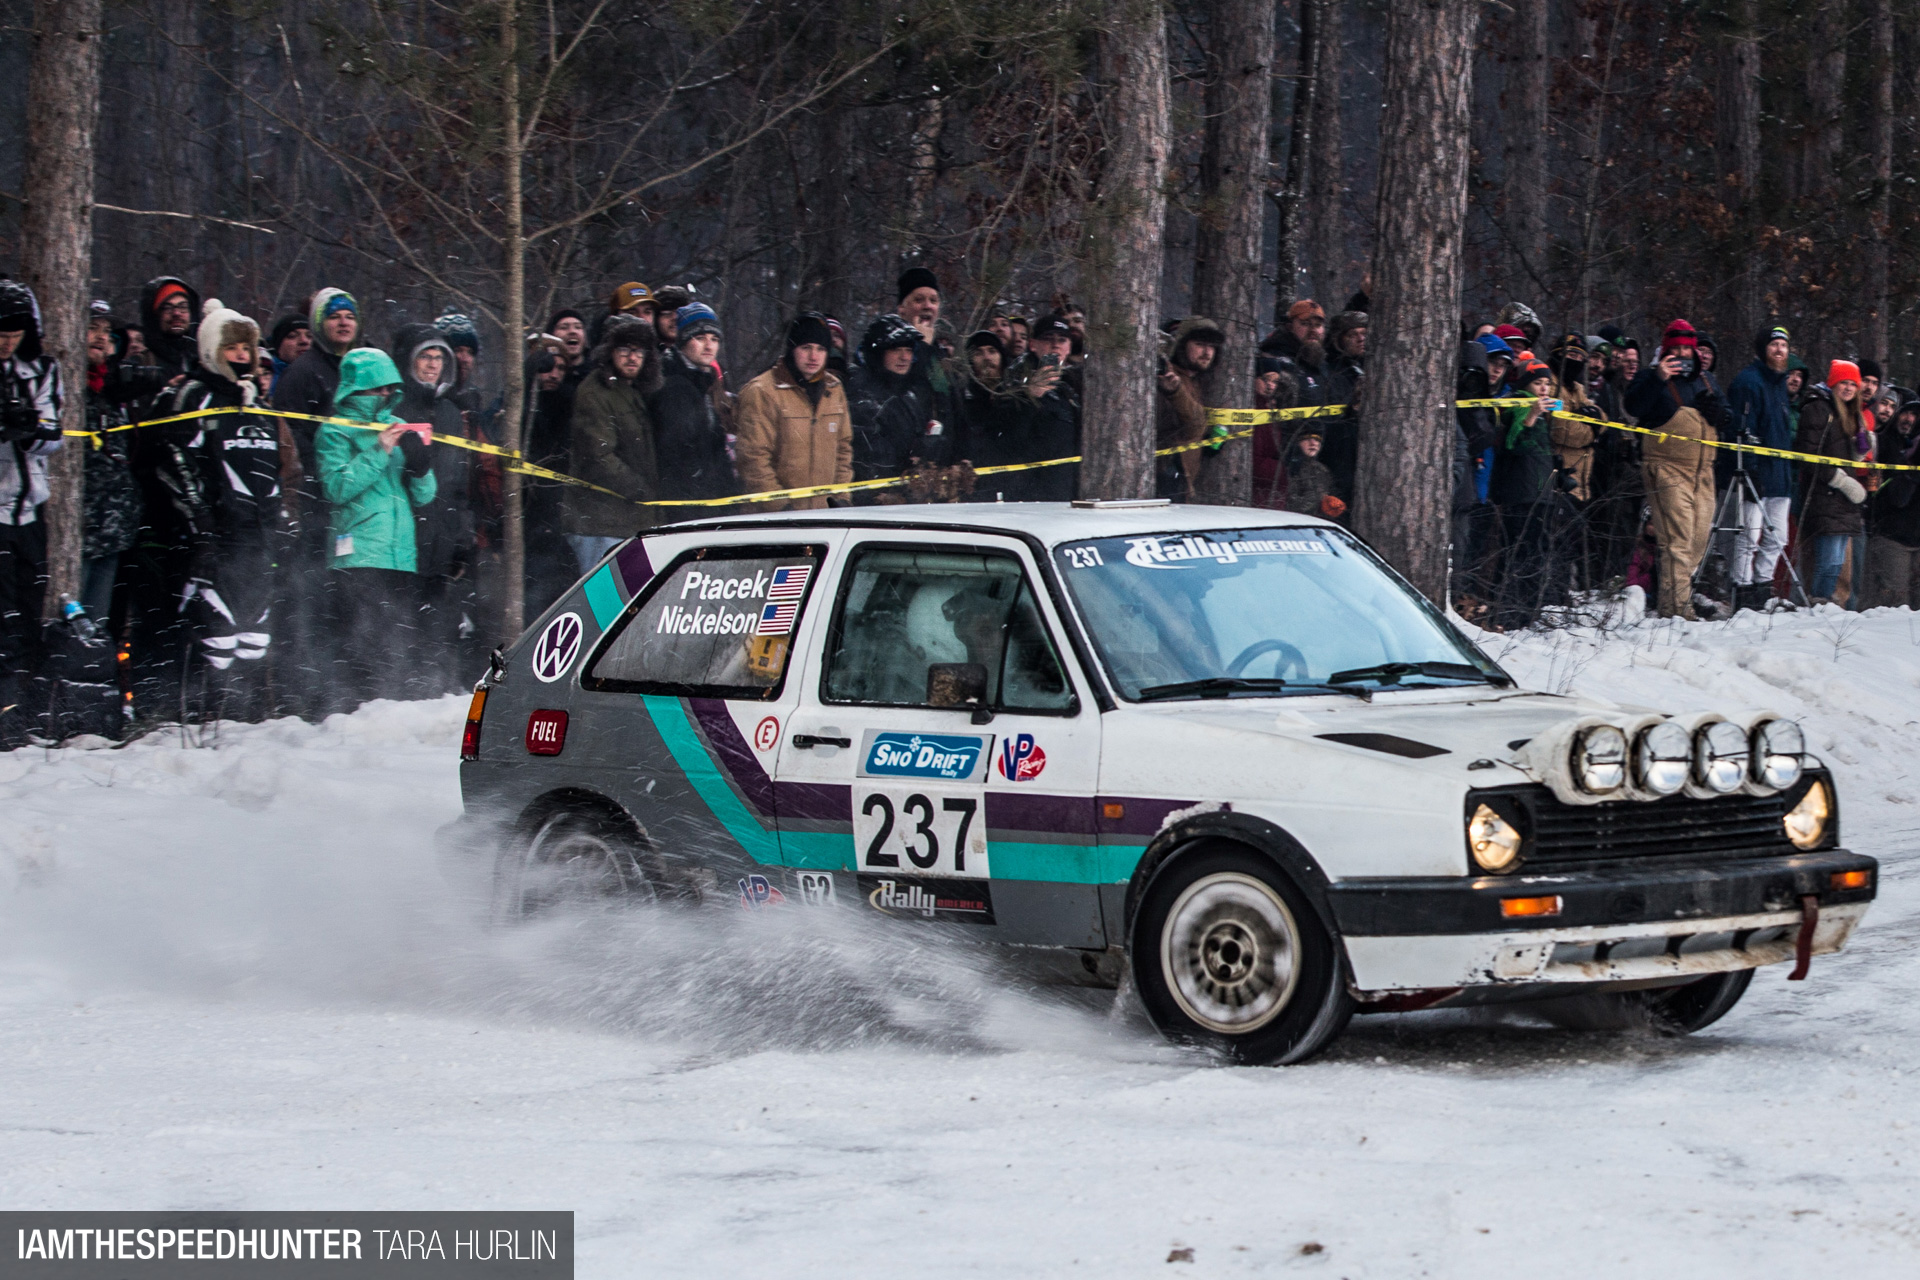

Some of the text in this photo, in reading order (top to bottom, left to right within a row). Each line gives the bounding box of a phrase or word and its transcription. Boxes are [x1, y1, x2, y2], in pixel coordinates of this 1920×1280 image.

[223, 438, 278, 450] POLARI
[1064, 546, 1104, 569] 237
[1124, 536, 1327, 565] Rally AMERICA
[680, 569, 769, 600] Ptacek
[656, 605, 758, 634] Nickelson
[531, 720, 558, 742] FUEL
[761, 724, 773, 743] E
[873, 743, 971, 770] SNO DRIFT
[1003, 733, 1034, 781] VP
[941, 768, 958, 778] Rally
[862, 793, 977, 871] 237
[878, 880, 936, 917] Rally
